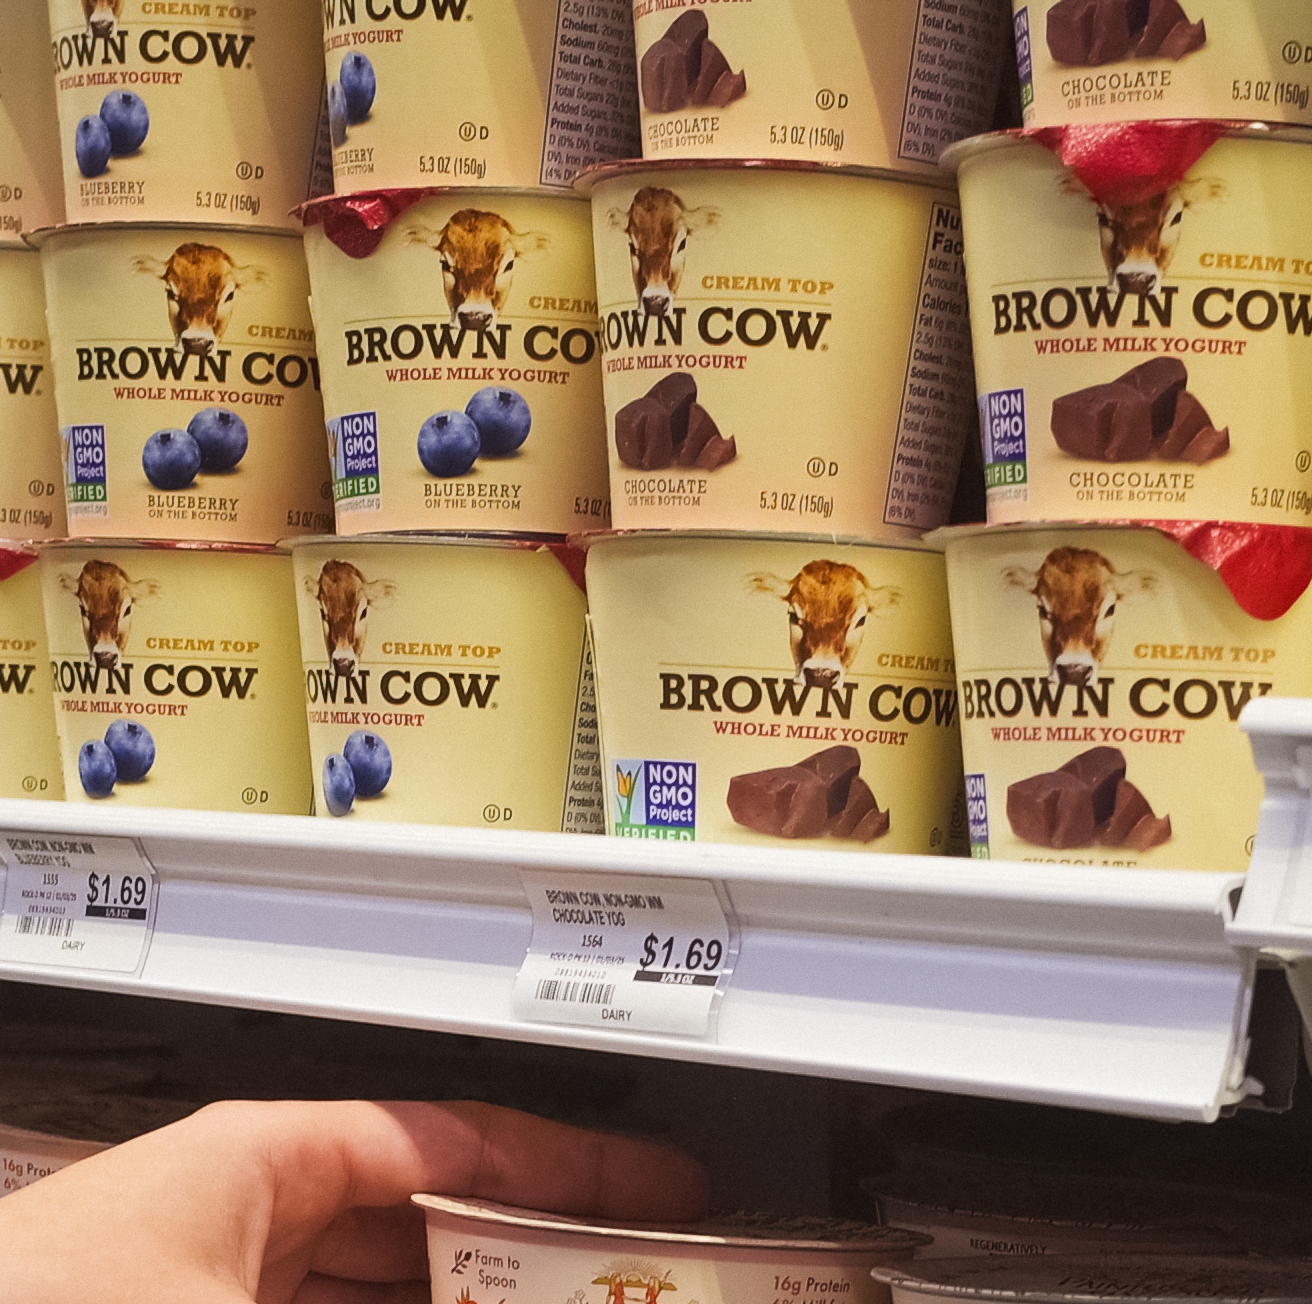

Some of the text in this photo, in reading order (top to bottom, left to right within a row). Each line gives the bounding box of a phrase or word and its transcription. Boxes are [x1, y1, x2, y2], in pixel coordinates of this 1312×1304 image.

[1061, 69, 1172, 96] CHOCOLATE
[1232, 80, 1251, 100] 5.3
[1254, 81, 1270, 102] OZ
[1199, 252, 1284, 272] CREAM
[701, 276, 835, 294] CREAM TOP
[992, 287, 1178, 335] BROWN
[7, 338, 45, 352] TOP
[346, 324, 510, 366] BROWN
[1035, 336, 1247, 355] WHOLE MILK YOGURT
[77, 348, 231, 382] BROWN
[386, 367, 569, 386] WHOLE MILK YOGURT
[343, 418, 375, 436] NON
[345, 436, 375, 456] GMO
[346, 455, 377, 471] Project
[624, 479, 707, 495] CHOCOLATE
[1069, 471, 1194, 489] CHOCOLATE
[147, 495, 239, 512] BLUEBERRY
[149, 509, 238, 521] ON THE BOTTOM
[147, 637, 260, 653] CREAM TOP
[382, 641, 501, 659] CREAM TOP
[1133, 644, 1276, 664] CREAM TOP
[660, 672, 858, 720] BROWN
[963, 677, 1115, 720] BROWN
[713, 721, 908, 746] WHOLE MILK YOGURT
[649, 763, 693, 785] NON
[649, 787, 693, 808] GMO
[649, 806, 692, 825] Project
[87, 872, 147, 908] $1.69
[639, 932, 722, 971] $1.69
[602, 1008, 632, 1021] DAIRY
[475, 1249, 520, 1271] Farm to
[478, 1268, 517, 1290] Spoon
[772, 1275, 850, 1295] 16g Protein
